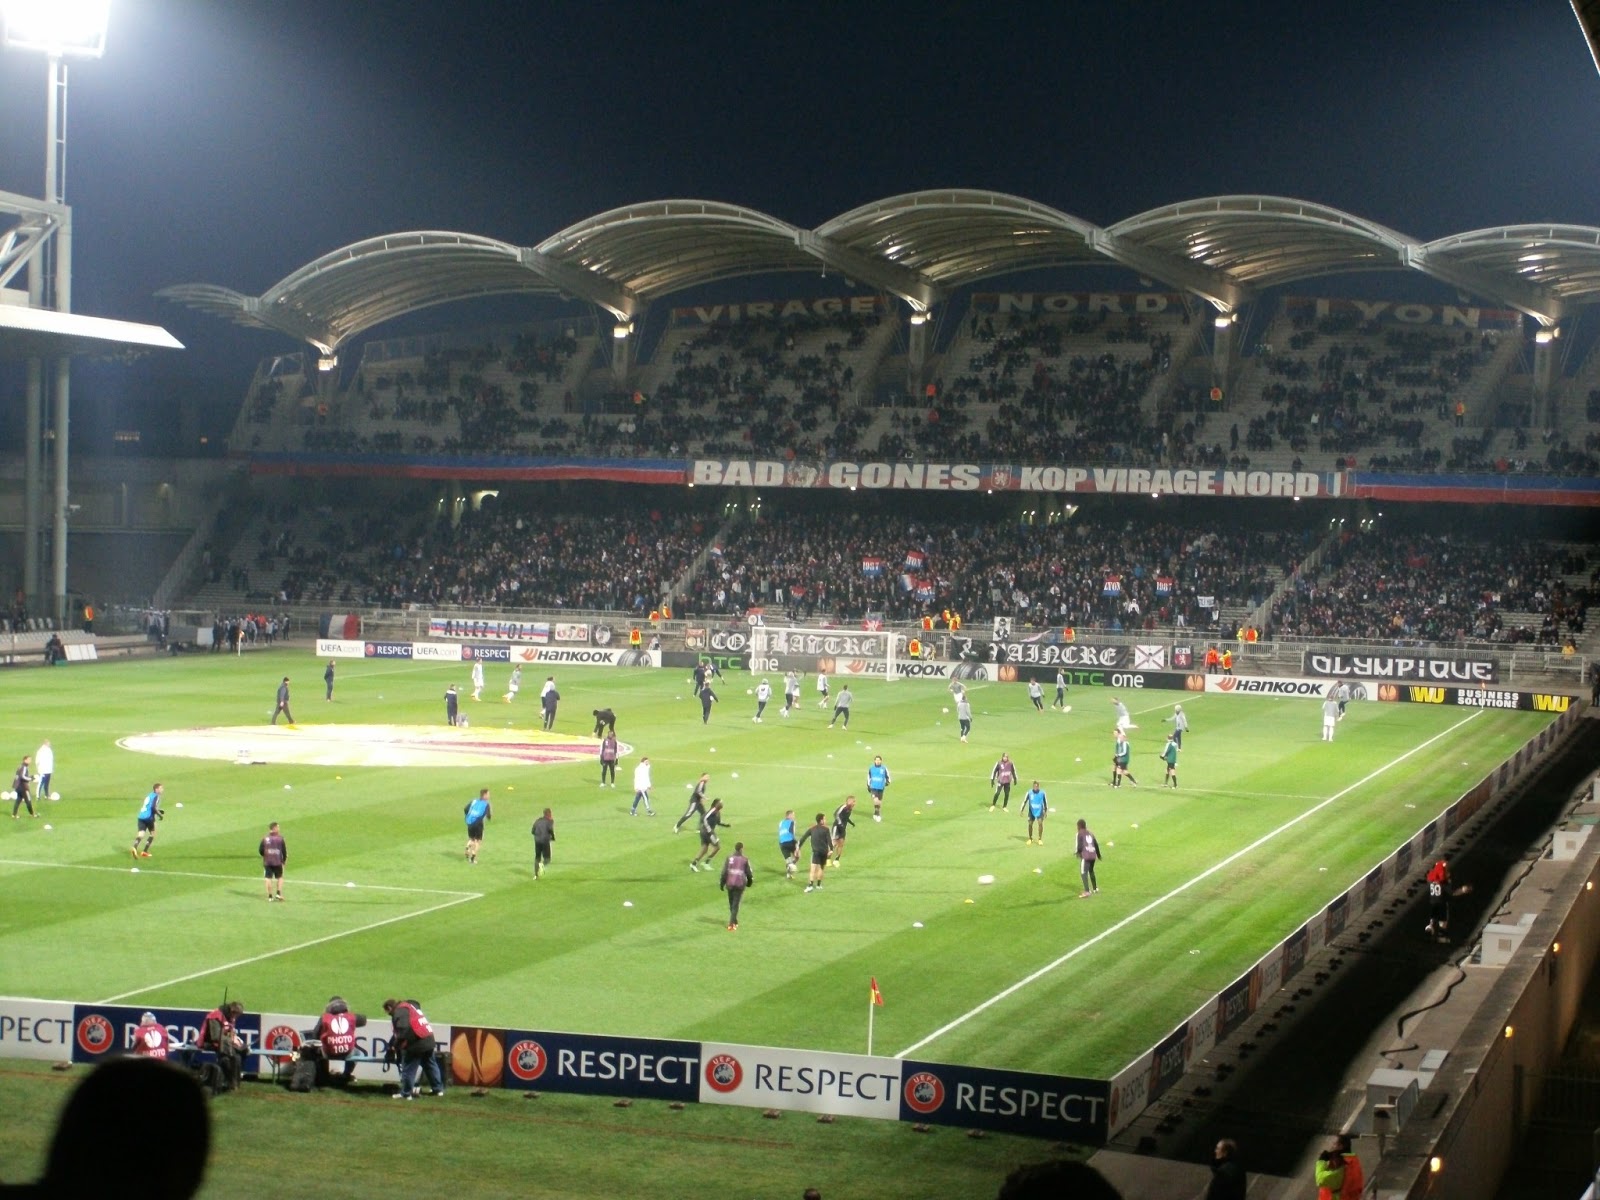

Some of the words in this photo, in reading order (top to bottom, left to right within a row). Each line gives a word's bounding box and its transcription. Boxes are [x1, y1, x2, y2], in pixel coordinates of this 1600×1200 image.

[694, 296, 875, 324] VIRAGE
[999, 294, 1168, 313] NORD
[694, 461, 784, 486] BAD
[828, 462, 981, 490] GONES
[1020, 467, 1087, 491] KOP
[1093, 468, 1216, 494] VIRAGE
[1222, 471, 1319, 496] NORD
[444, 620, 489, 638] ALLEZ
[377, 645, 413, 656] RESPECT
[474, 648, 510, 659] RESPECT
[748, 658, 778, 671] one
[1311, 655, 1492, 681] OLYMPIQUE
[1111, 673, 1144, 688] one
[1411, 686, 1445, 704] WU
[1457, 689, 1519, 701] BUSINESS
[1457, 698, 1517, 709] SOLUTIONS
[1535, 694, 1569, 712] WU
[328, 1035, 353, 1044] PHOTO
[516, 1041, 540, 1053] UEFA
[333, 1045, 349, 1054] 103
[558, 1049, 699, 1085] RESPECT
[712, 1054, 737, 1066] UEFA
[755, 1063, 898, 1102] RESPECT
[913, 1072, 937, 1086] UEFA
[956, 1082, 1104, 1125] RESPECT
